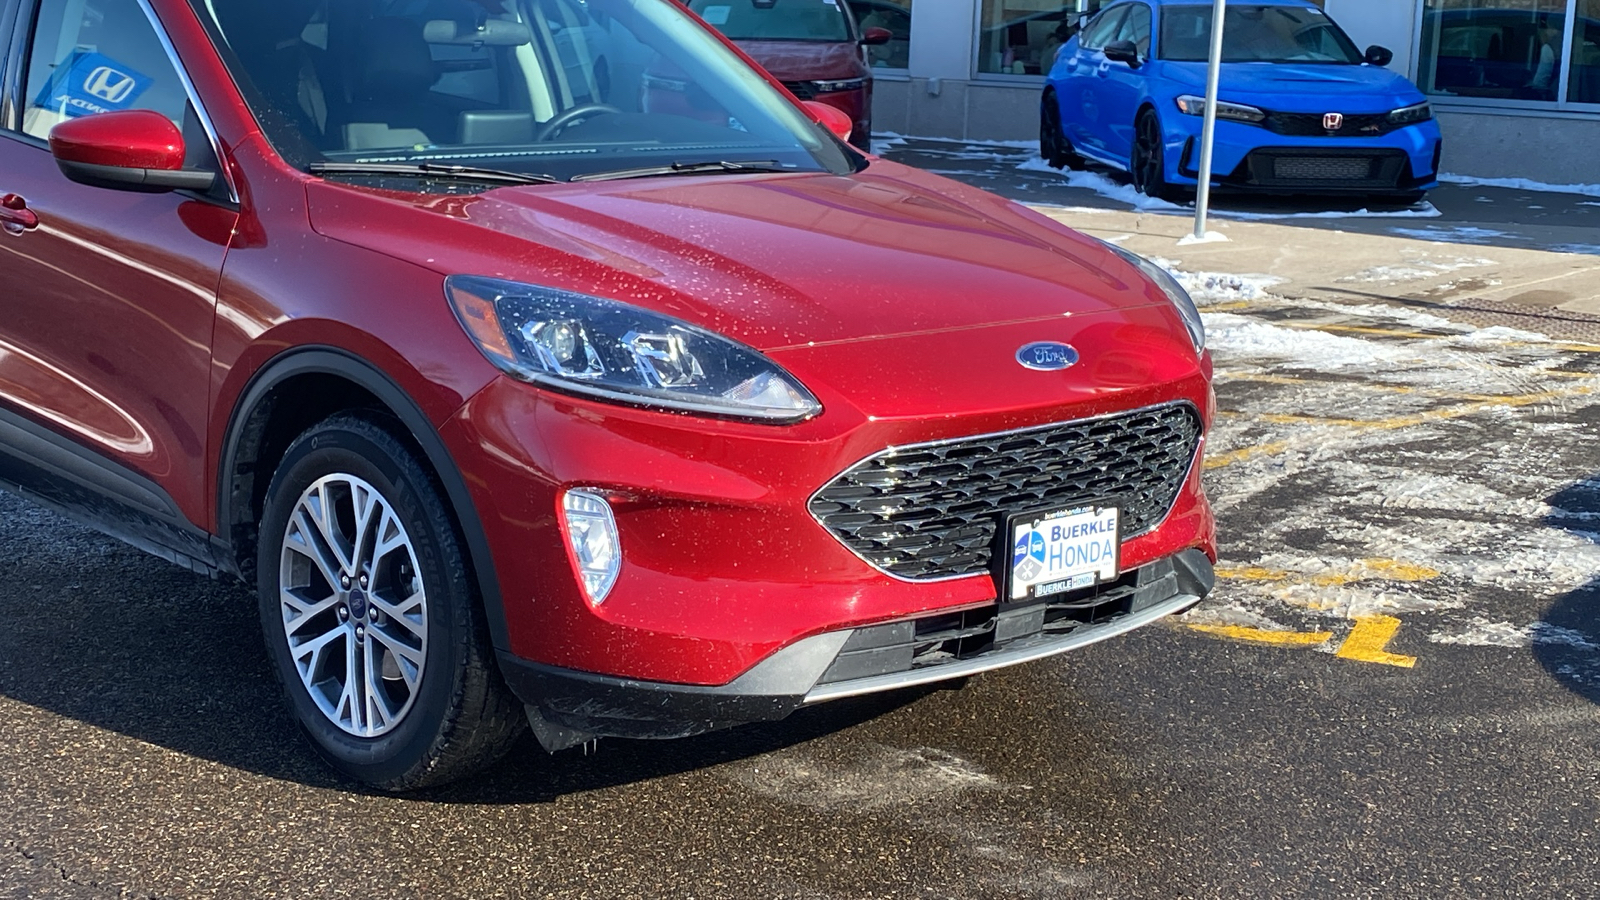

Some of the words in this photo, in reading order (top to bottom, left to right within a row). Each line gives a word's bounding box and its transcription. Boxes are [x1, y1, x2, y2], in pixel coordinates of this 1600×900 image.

[1033, 346, 1070, 364] Ford
[1051, 518, 1115, 542] BUERKLE
[1049, 539, 1113, 571] HONDA
[413, 520, 446, 627] MICHELIN
[1037, 580, 1072, 595] BUERKLE
[1073, 576, 1093, 587] HONDA
